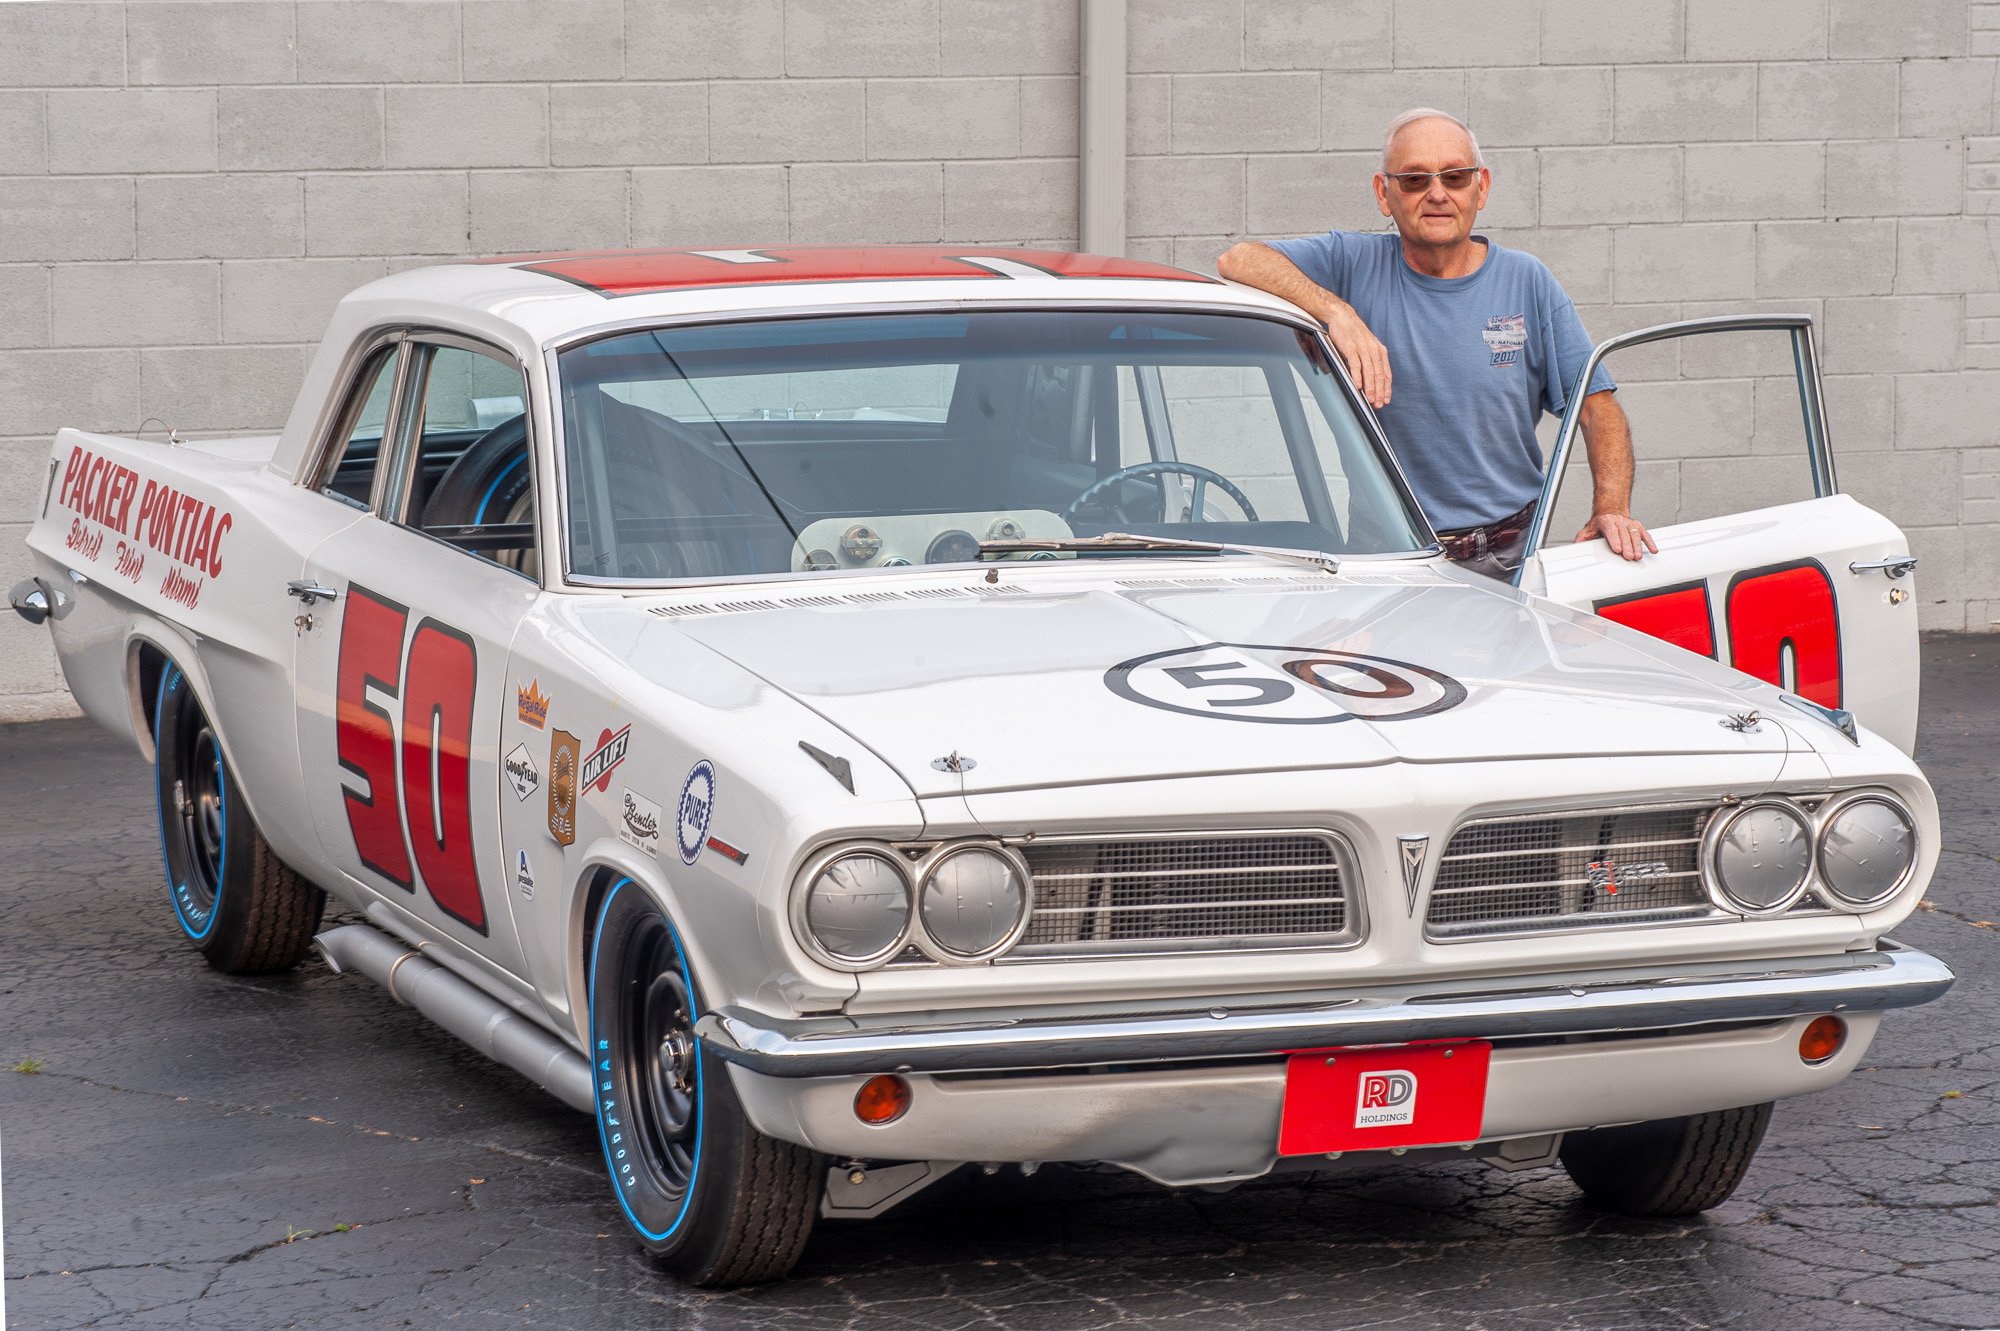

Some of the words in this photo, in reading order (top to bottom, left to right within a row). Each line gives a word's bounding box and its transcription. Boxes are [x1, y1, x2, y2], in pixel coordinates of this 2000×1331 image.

[1493, 351, 1517, 363] 2017
[59, 445, 139, 535] PACKER
[134, 479, 233, 579] PONTIAC
[65, 517, 104, 563] Detroit
[114, 540, 145, 584] Flint
[159, 566, 203, 610] Miami
[1158, 659, 1415, 708] 50
[336, 580, 490, 938] 50
[583, 758, 603, 788] AIR
[604, 731, 630, 767] LIFT
[684, 793, 707, 830] PURE
[598, 1039, 636, 1188] GOODYEAR
[1360, 1112, 1408, 1123] HOLDINGS
[1362, 1074, 1413, 1109] RD
